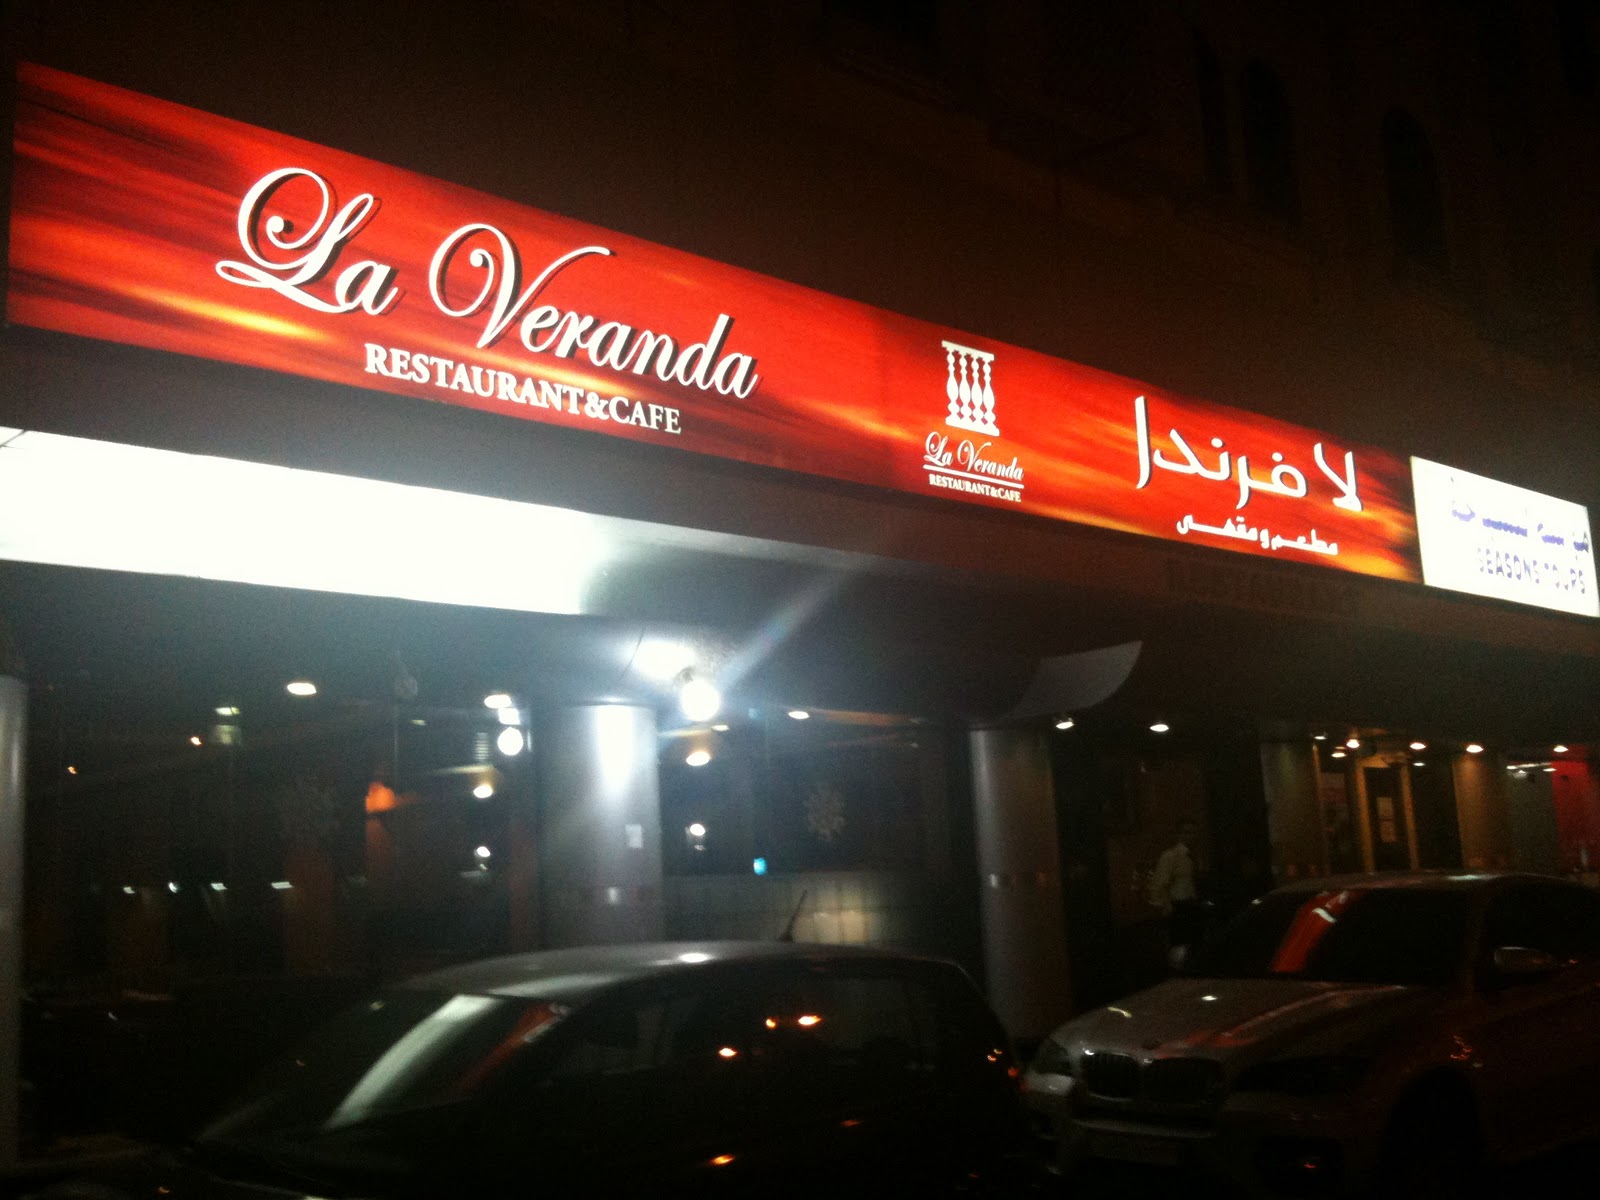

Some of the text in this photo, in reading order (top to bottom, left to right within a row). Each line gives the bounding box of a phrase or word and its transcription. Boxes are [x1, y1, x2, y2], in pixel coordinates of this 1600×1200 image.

[215, 167, 759, 398] La Veranda
[365, 343, 682, 434] RESTAURANT&CAFE
[923, 432, 1024, 481] La Veranda
[929, 474, 1022, 502] RESTAURANT&CAFE
[1135, 395, 1362, 512] لا فرندا
